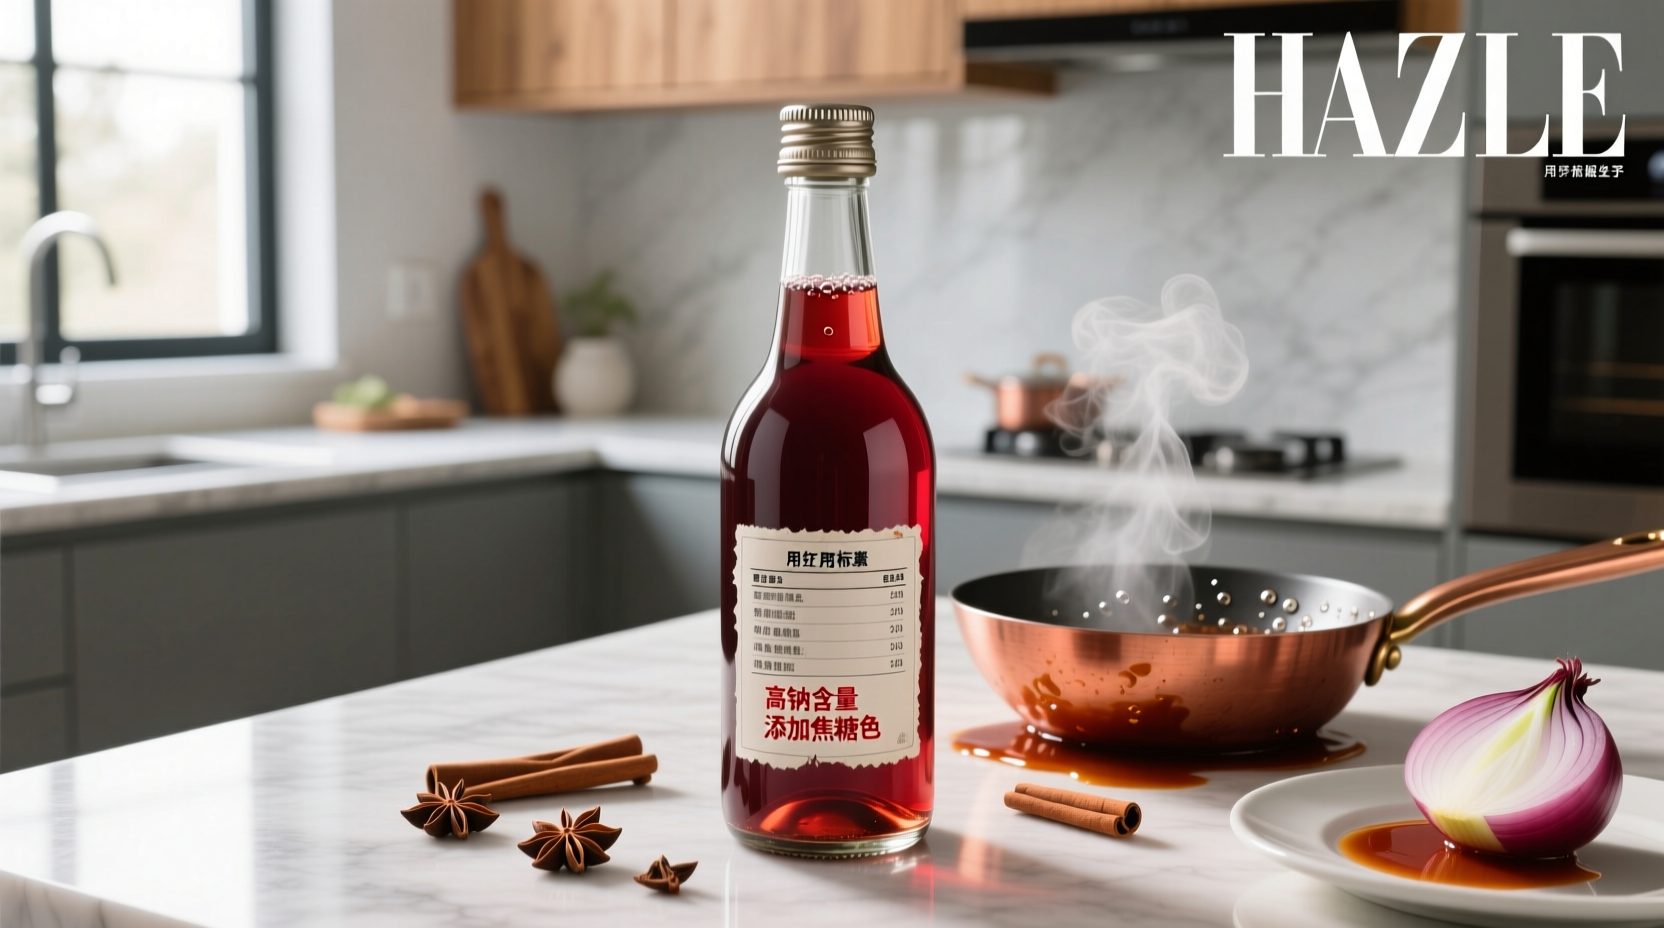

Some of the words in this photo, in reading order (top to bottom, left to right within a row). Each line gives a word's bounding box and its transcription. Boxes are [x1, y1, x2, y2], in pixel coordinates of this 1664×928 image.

[765, 685, 858, 712] 高钠含量
[764, 714, 881, 742] 添加焦糖色
